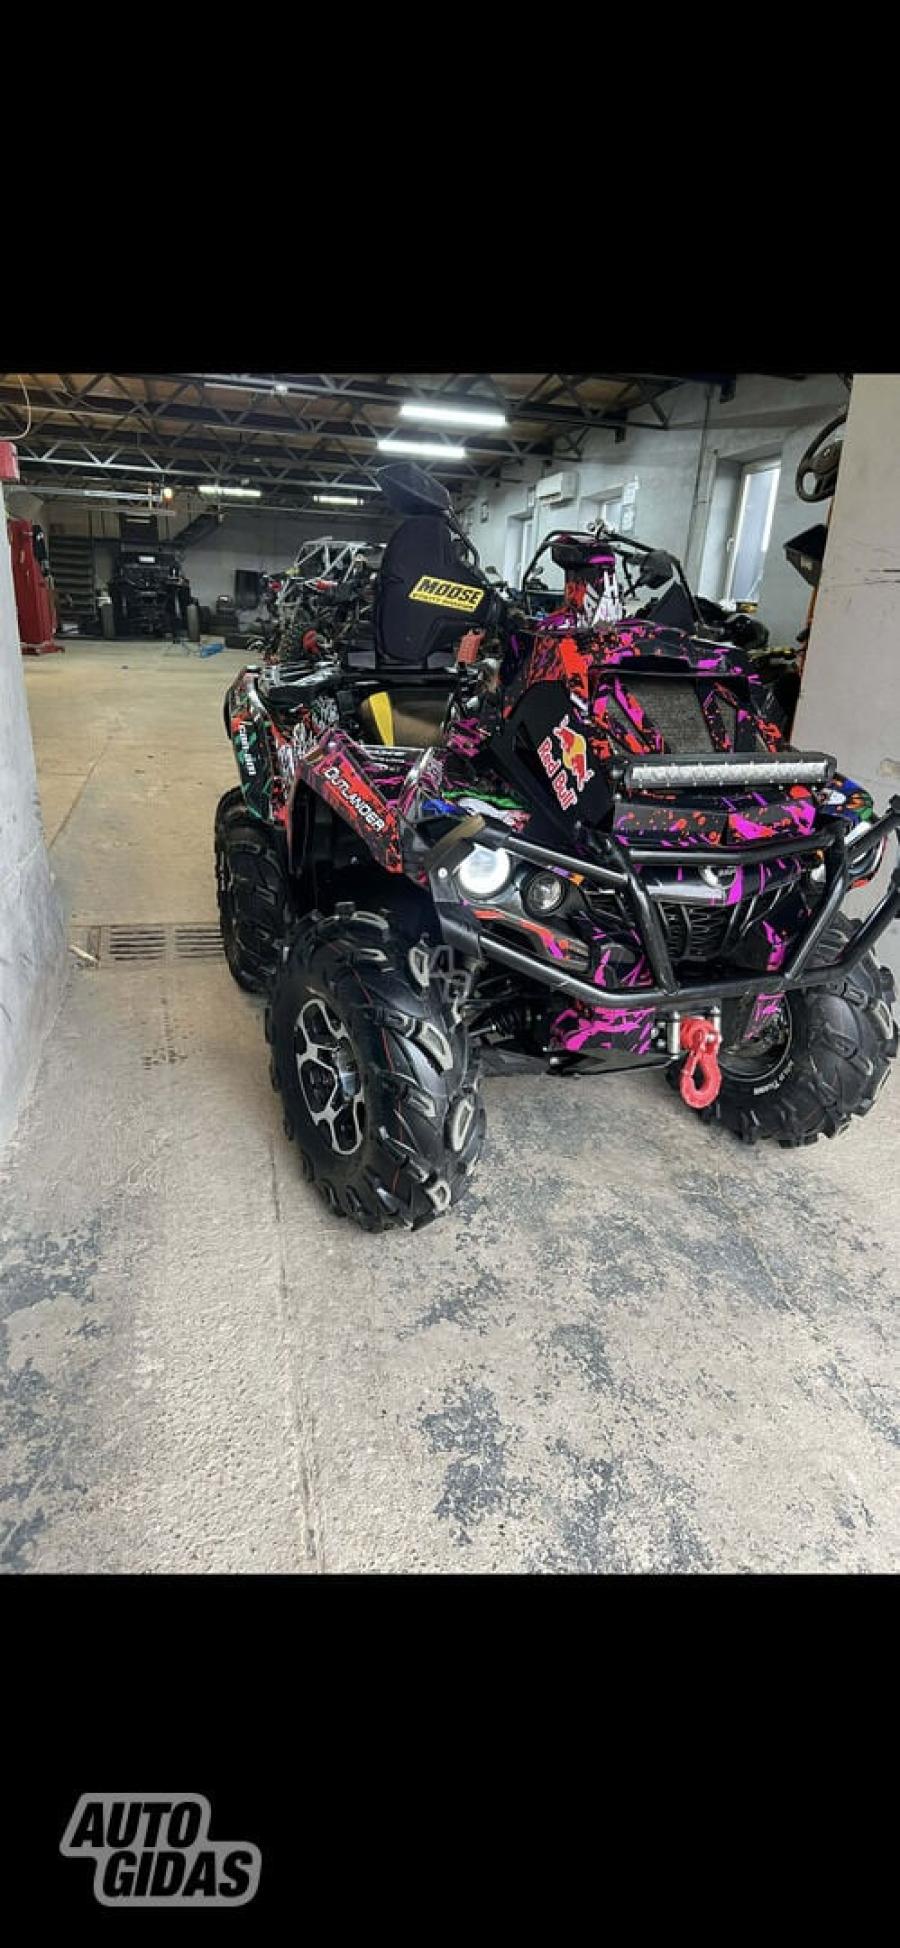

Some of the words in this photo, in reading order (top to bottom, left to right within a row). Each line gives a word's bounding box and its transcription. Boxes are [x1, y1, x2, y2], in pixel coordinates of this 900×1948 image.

[416, 578, 482, 604] MOOSE
[324, 766, 385, 832] OUTLANDER
[537, 736, 561, 778] Red
[552, 769, 577, 810] Bull
